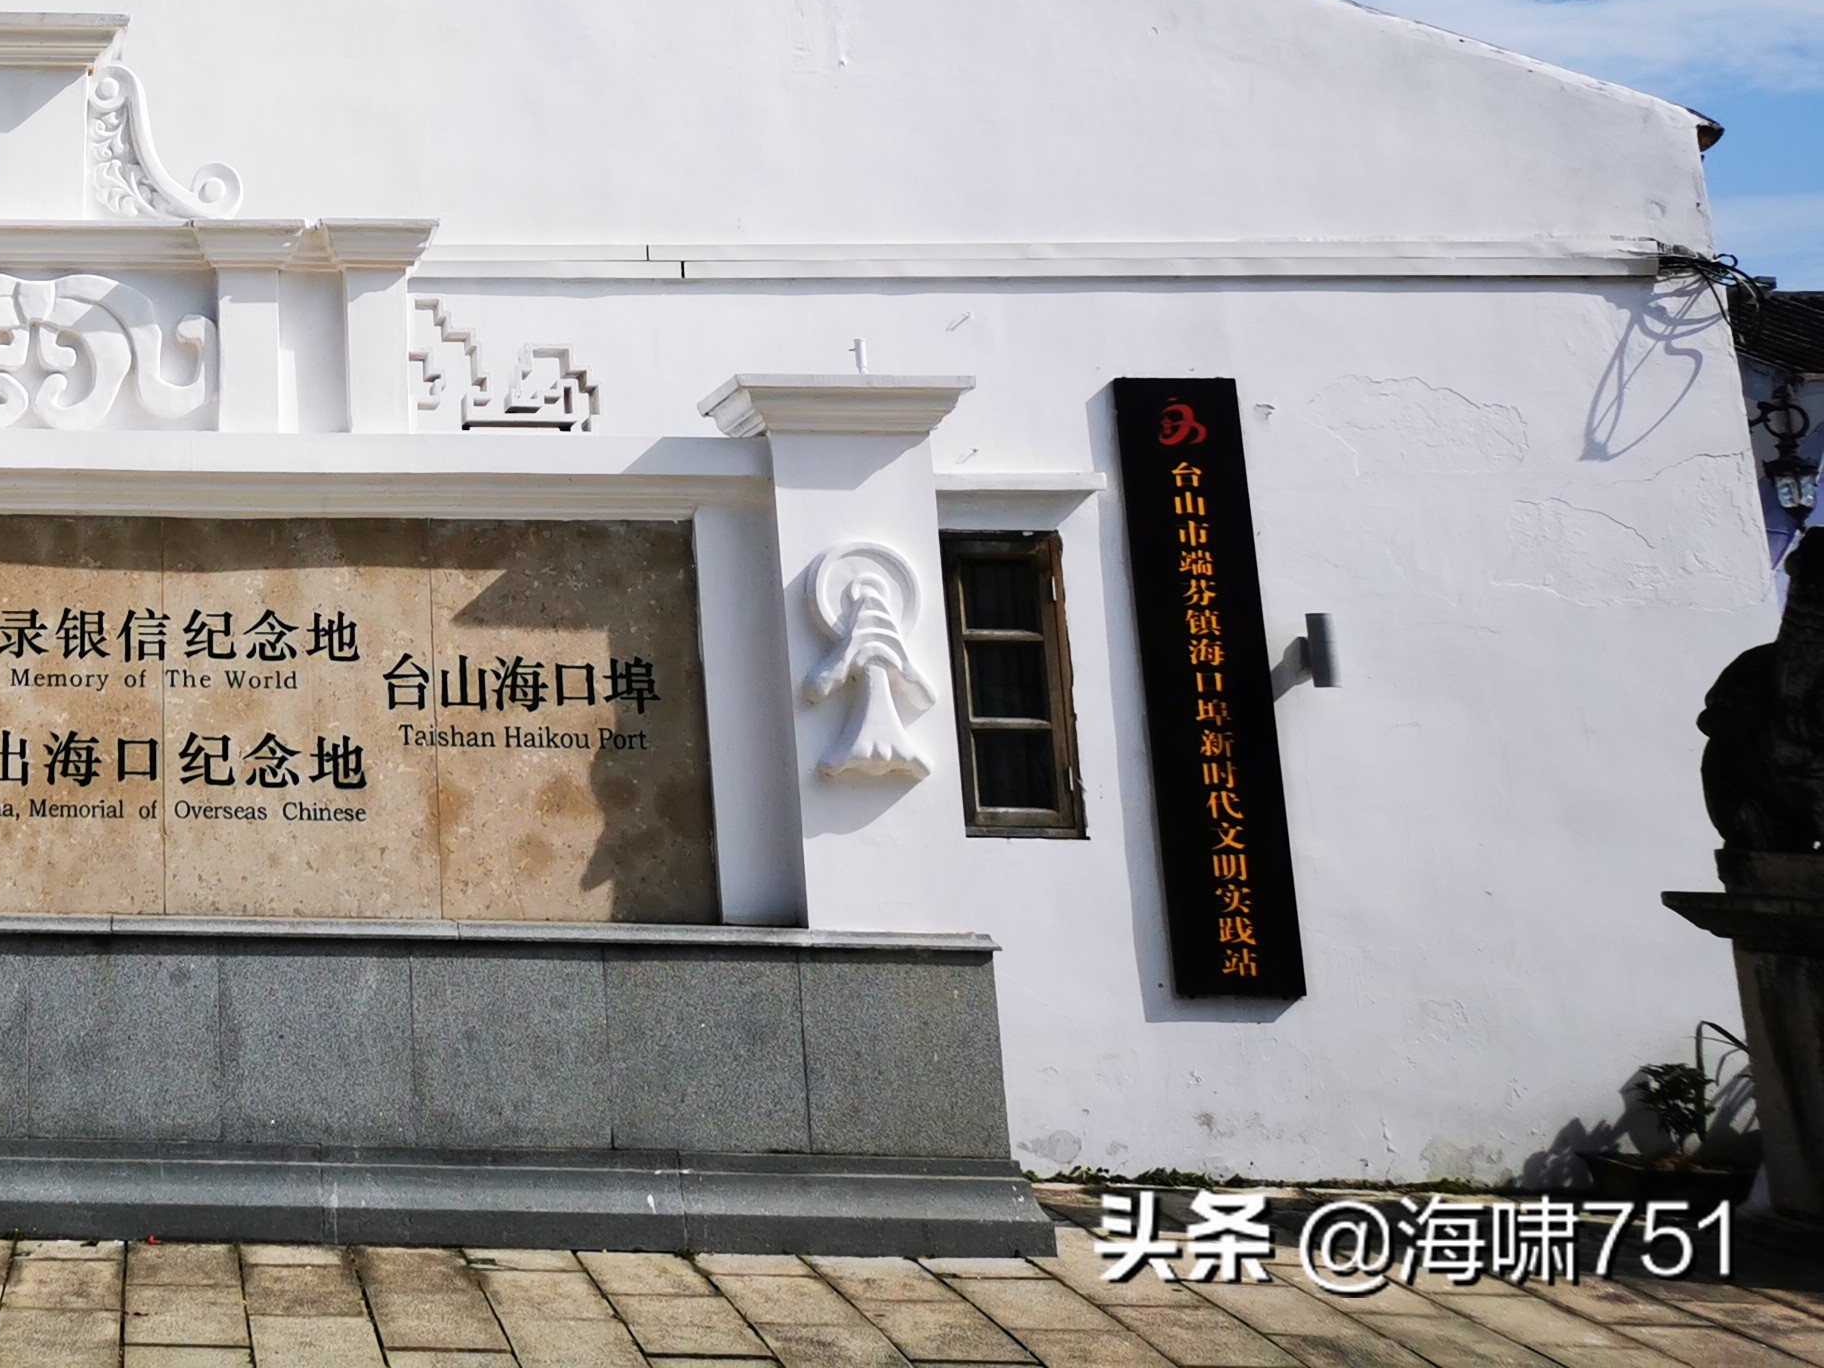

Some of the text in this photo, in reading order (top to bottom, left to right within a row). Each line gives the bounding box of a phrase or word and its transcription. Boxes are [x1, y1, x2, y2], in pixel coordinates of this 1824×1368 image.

[10, 668, 110, 692] Memory
[123, 669, 148, 688] of
[165, 669, 212, 689] The
[224, 670, 298, 690] World
[382, 652, 661, 714] 台山海口埠
[1171, 462, 1258, 977] 台山市端芬镇海口埠新时代文明实践站
[398, 724, 649, 750] Taishan Haikou Port
[28, 798, 124, 819] Memorial
[138, 799, 159, 820] of
[174, 800, 267, 820] Overseas
[282, 801, 367, 822] Chinese
